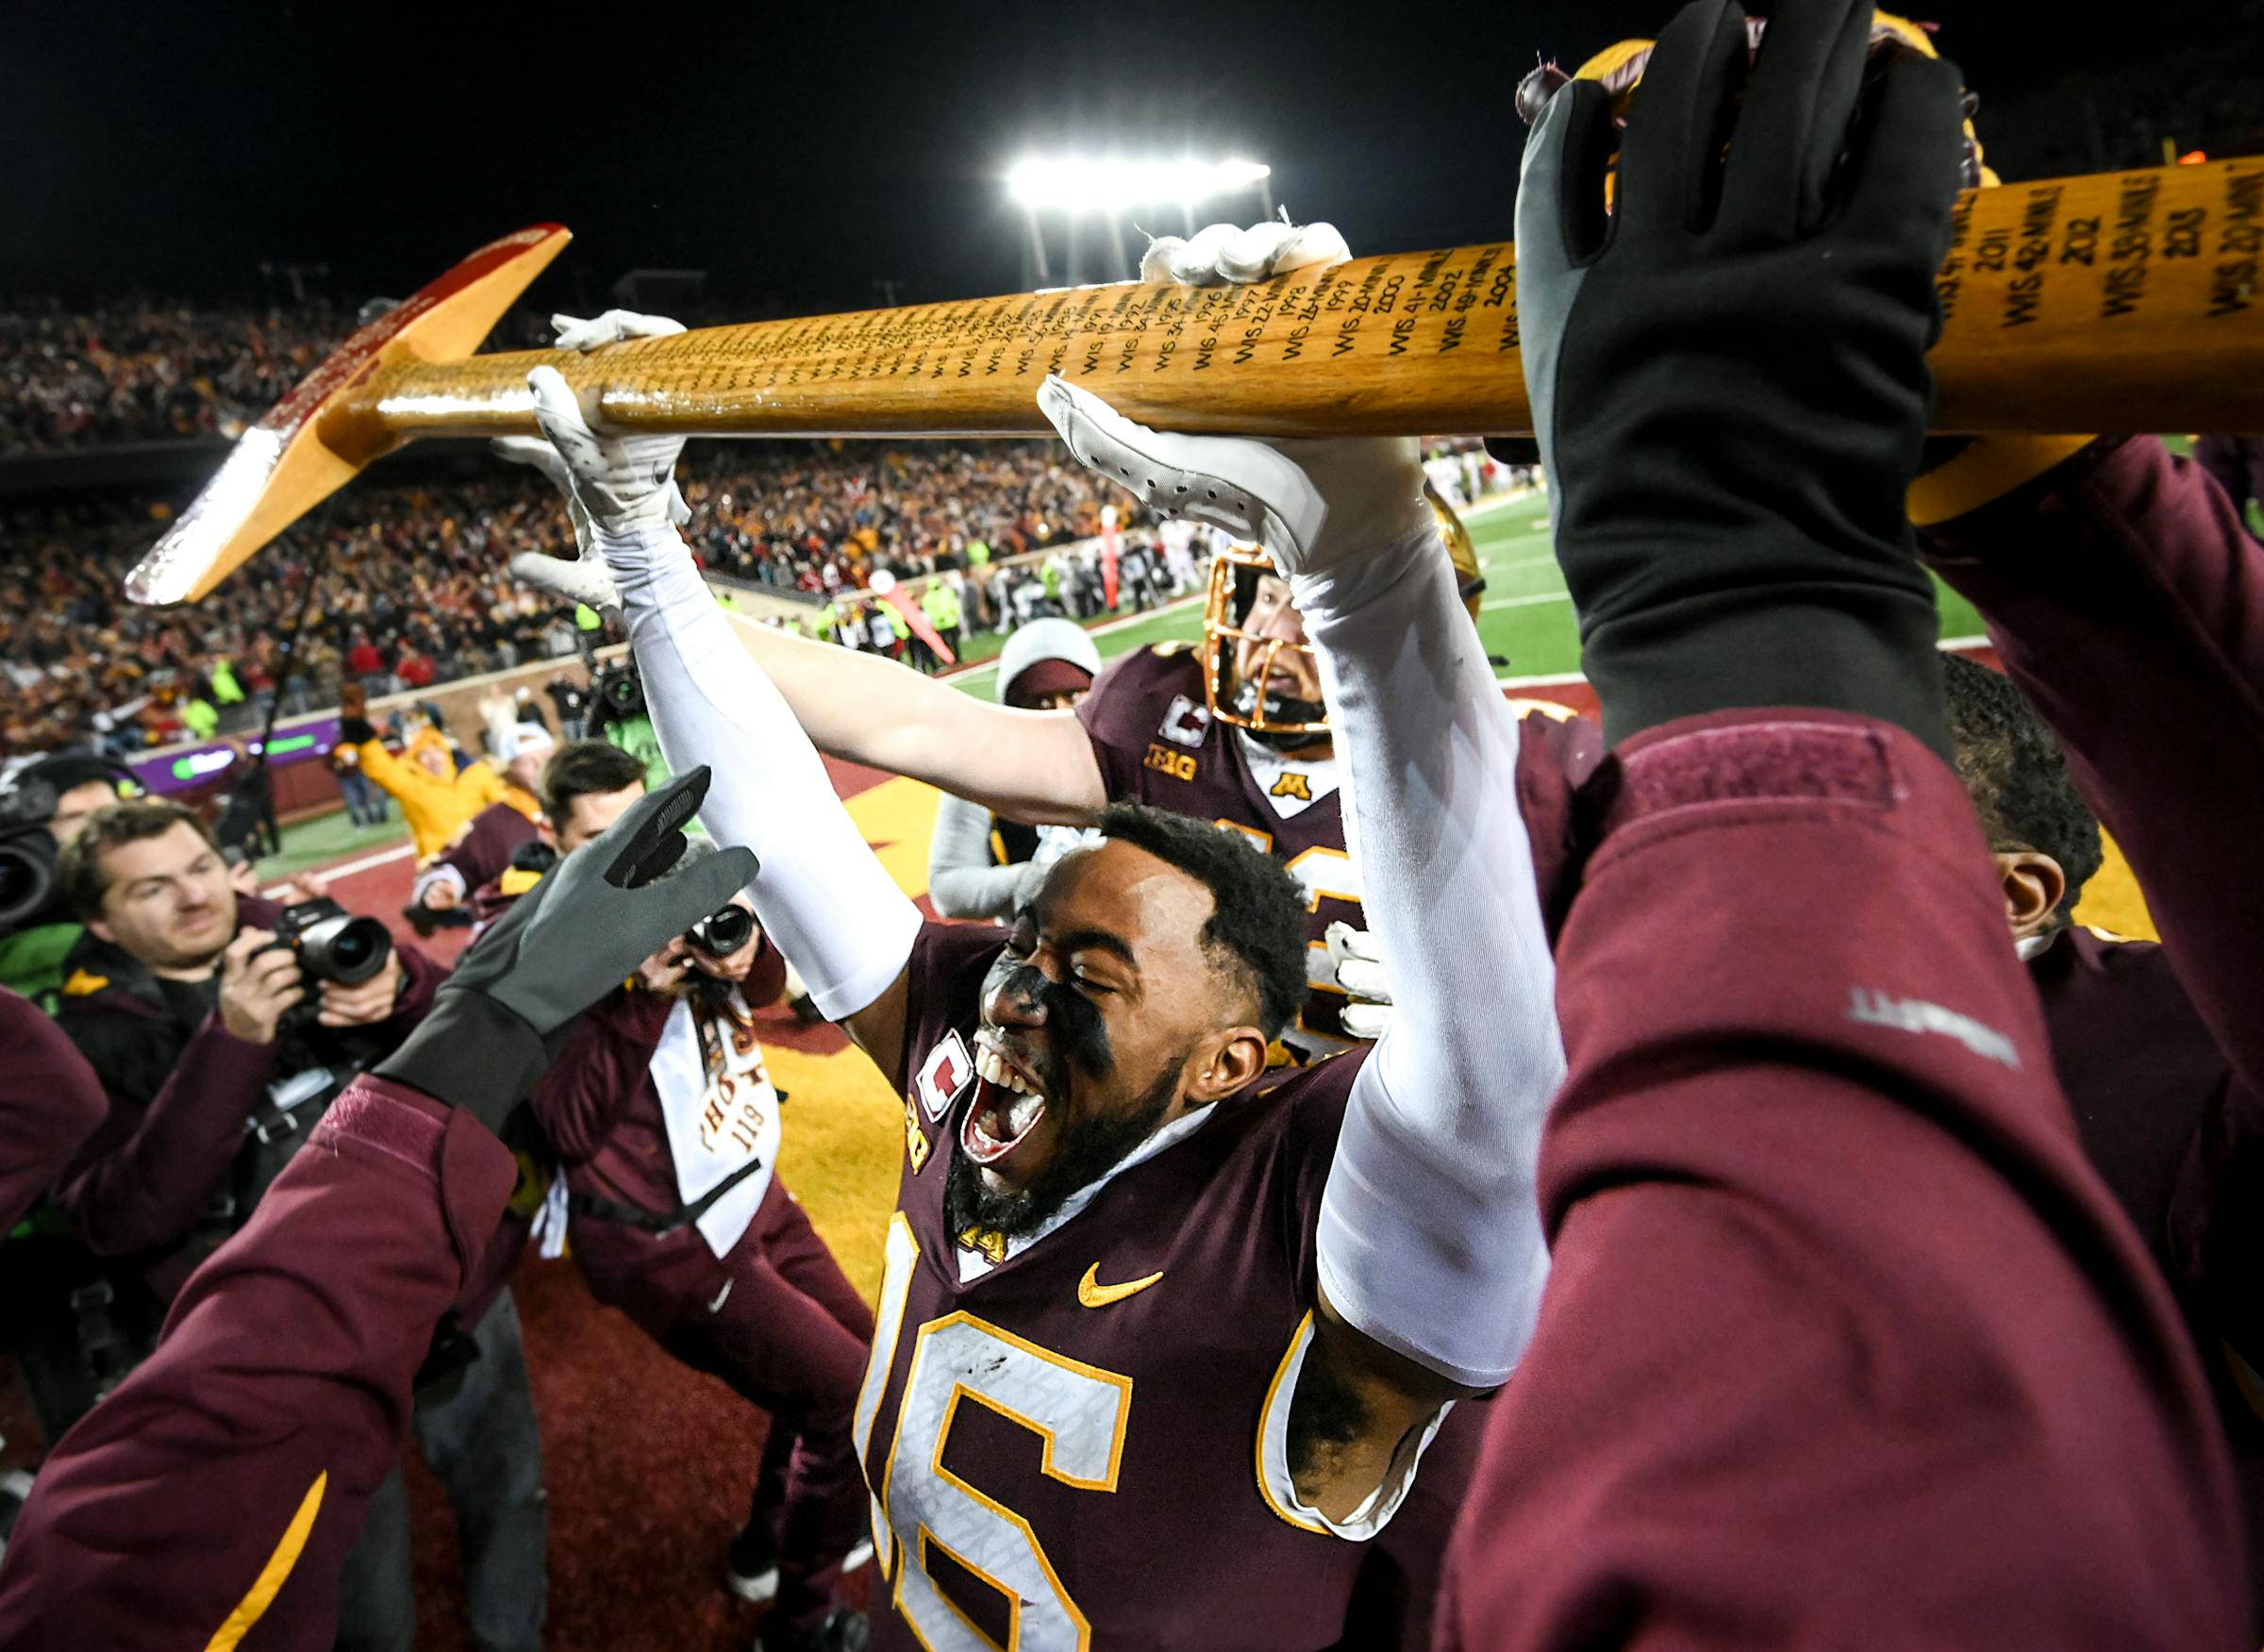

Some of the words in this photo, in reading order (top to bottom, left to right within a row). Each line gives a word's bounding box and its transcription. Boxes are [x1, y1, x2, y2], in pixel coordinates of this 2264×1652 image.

[1973, 228, 2010, 273] 2011
[1232, 289, 1257, 321] 1997
[1277, 286, 1307, 317] 1998
[1325, 280, 1356, 312] 1999
[1373, 275, 1406, 314] 2000
[1429, 269, 1464, 313] 2002
[1484, 264, 1516, 309] 2004
[1117, 299, 1147, 331] 1992
[1193, 291, 1223, 324] 1996
[1157, 693, 1210, 748] C
[1270, 772, 1312, 800] M
[921, 1036, 971, 1115] C
[731, 1104, 765, 1153] 119
